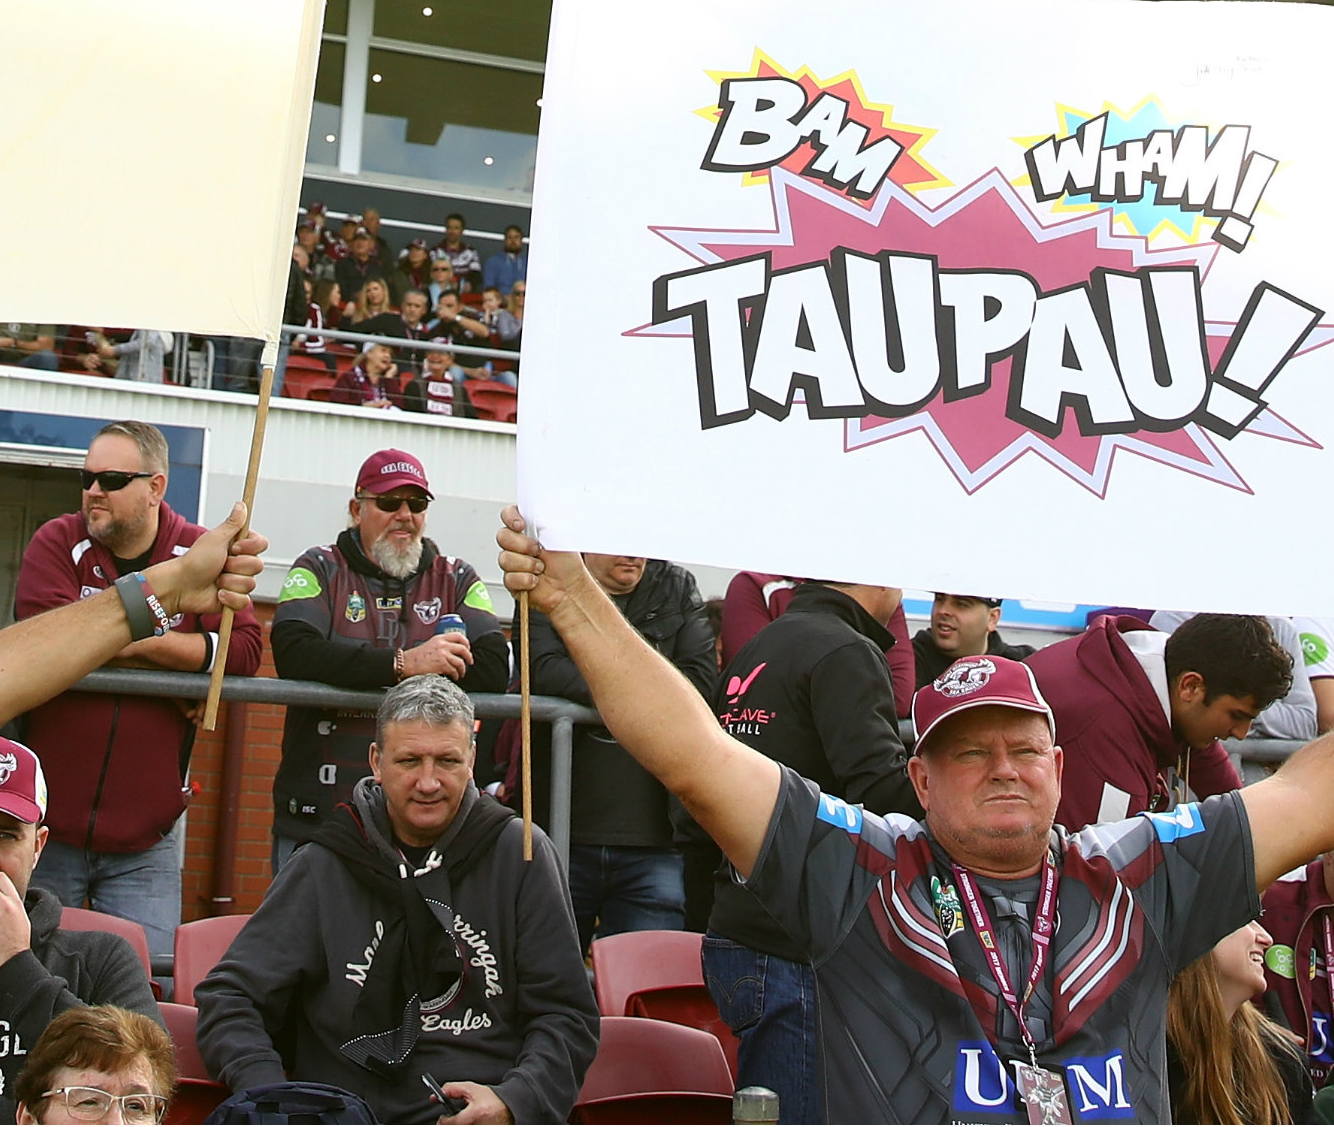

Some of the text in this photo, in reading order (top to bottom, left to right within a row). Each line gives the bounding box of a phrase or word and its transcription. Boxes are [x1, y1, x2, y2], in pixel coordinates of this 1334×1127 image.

[700, 76, 1279, 254] BAM WHAM!
[652, 245, 1326, 440] TAUPAU!
[420, 1007, 493, 1036] Eagles
